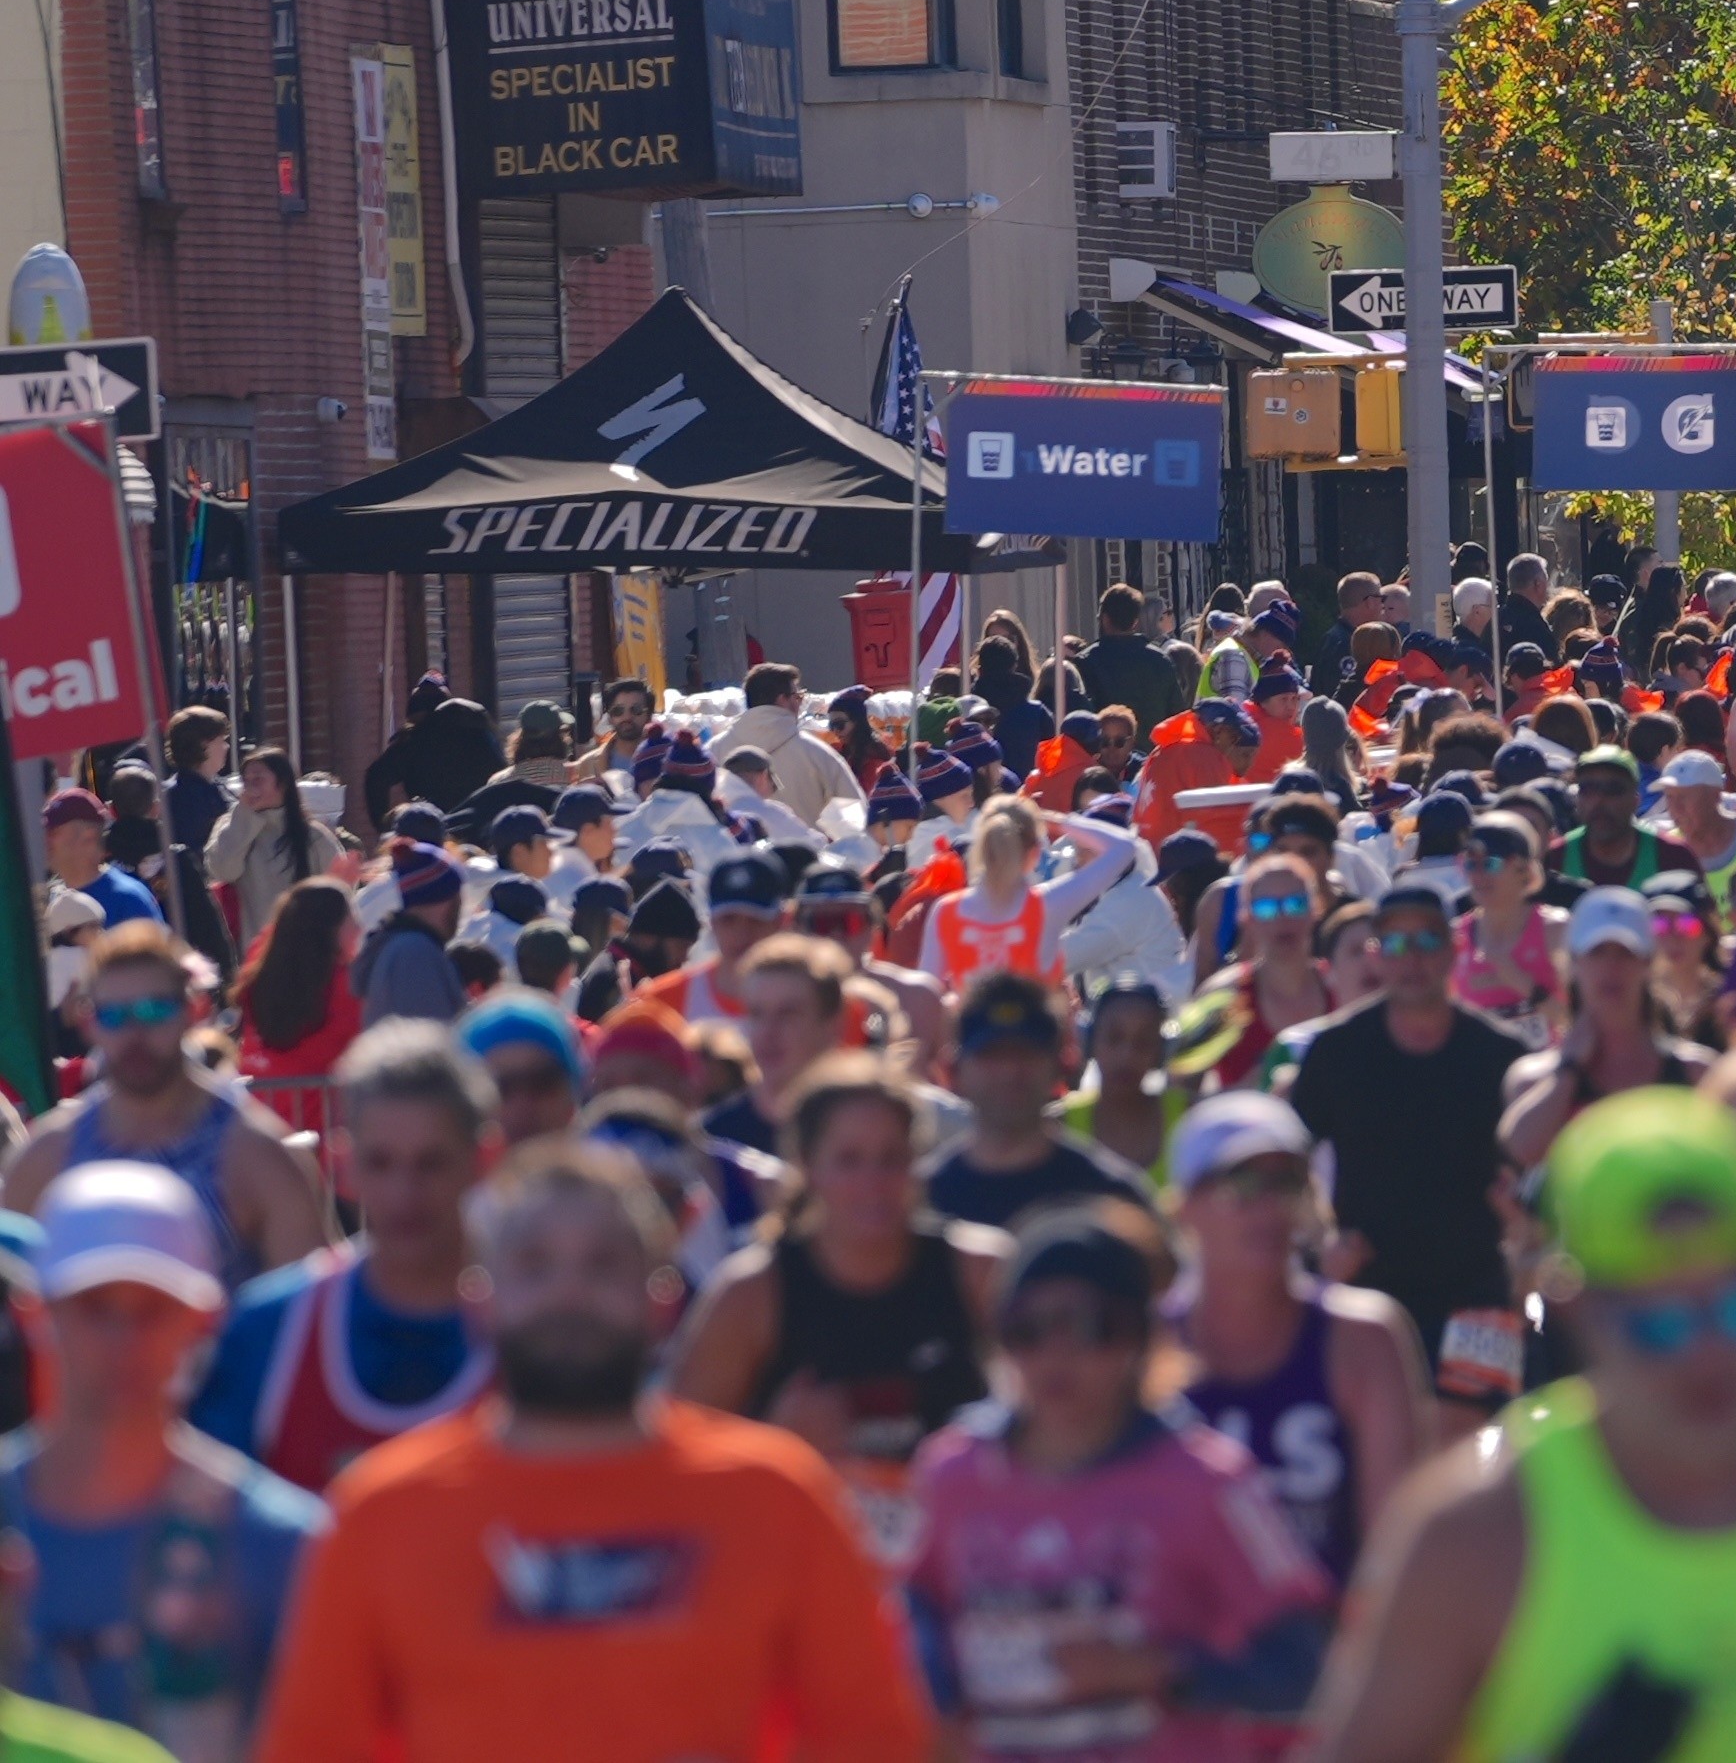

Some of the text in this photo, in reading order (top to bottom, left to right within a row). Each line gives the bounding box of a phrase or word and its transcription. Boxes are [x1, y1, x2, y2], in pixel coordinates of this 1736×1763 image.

[489, 56, 676, 101] SPECIALIST
[567, 102, 600, 133] IN
[495, 133, 679, 178] BLACK CAR
[1290, 142, 1341, 174] 46
[1360, 292, 1406, 313] ONE
[20, 374, 107, 413] WAY
[1037, 443, 1149, 477] Water
[428, 501, 819, 556] SPECIALIZED
[4, 638, 120, 719] ical
